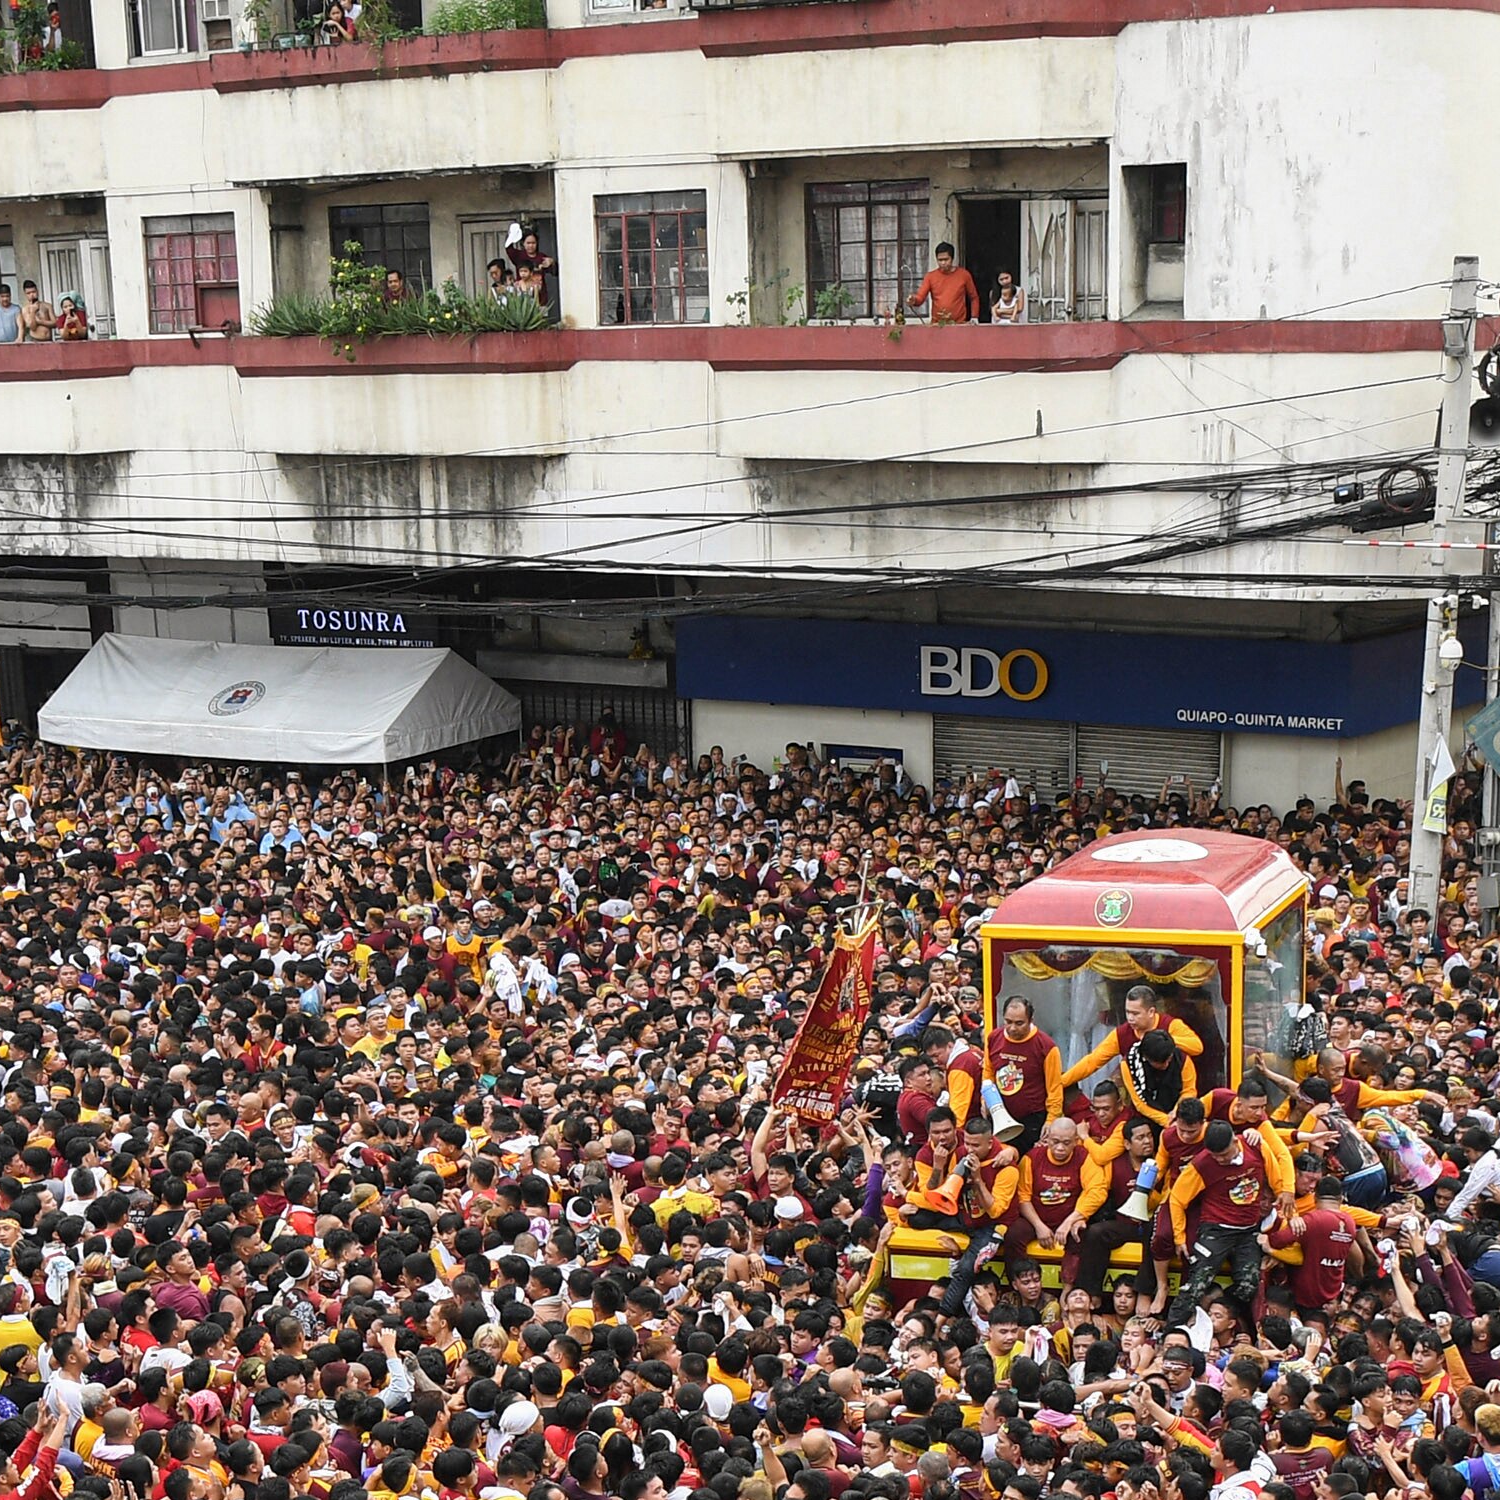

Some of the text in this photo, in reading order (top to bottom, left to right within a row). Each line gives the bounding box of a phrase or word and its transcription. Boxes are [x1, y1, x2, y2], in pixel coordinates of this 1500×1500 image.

[297, 609, 407, 633] TOSUNRA
[919, 644, 1049, 702] BDO
[1288, 715, 1343, 731] MARKET
[820, 984, 840, 1013] ALAY
